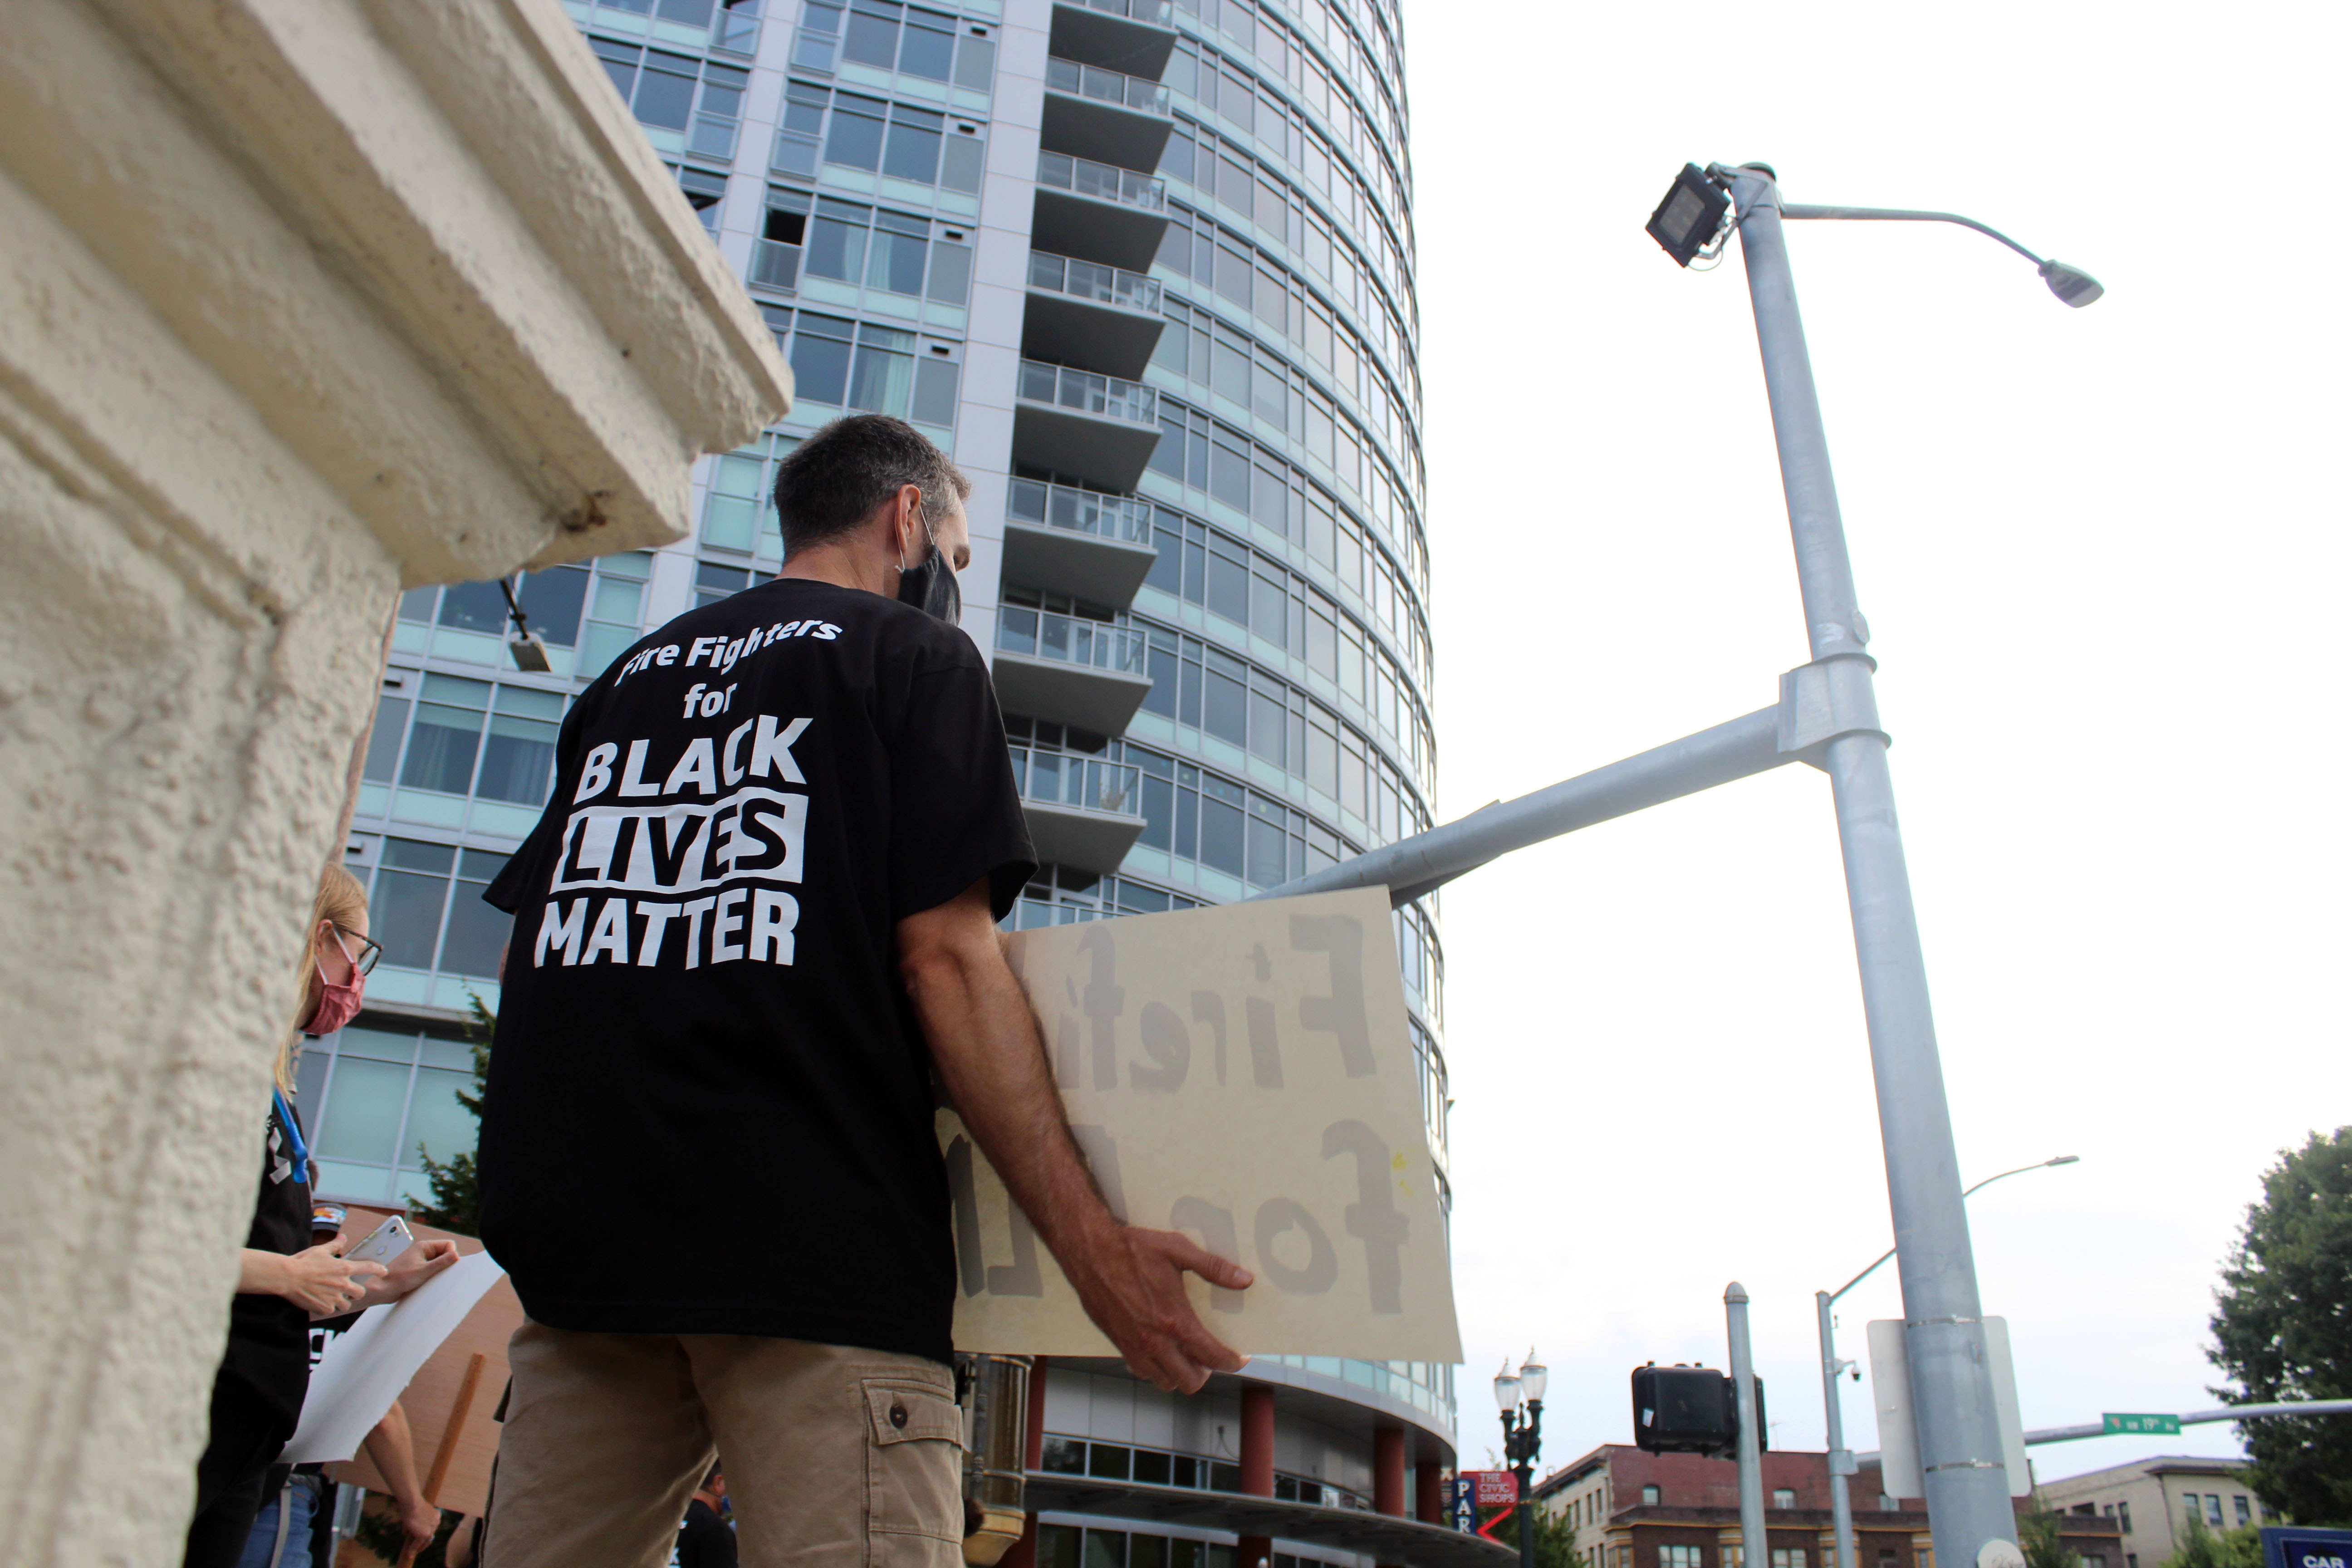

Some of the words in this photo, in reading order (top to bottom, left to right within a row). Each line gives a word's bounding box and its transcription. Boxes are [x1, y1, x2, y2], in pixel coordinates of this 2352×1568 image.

[614, 643, 680, 687] Fire
[685, 619, 843, 675] Fighters
[683, 683, 738, 719] for
[573, 714, 813, 805] BLACK
[560, 797, 787, 887] LIVES
[534, 888, 799, 970] MATTER
[1479, 1472, 1501, 1483] THE
[1479, 1483, 1510, 1493] CIVIC
[1479, 1493, 1515, 1503] SHOPS
